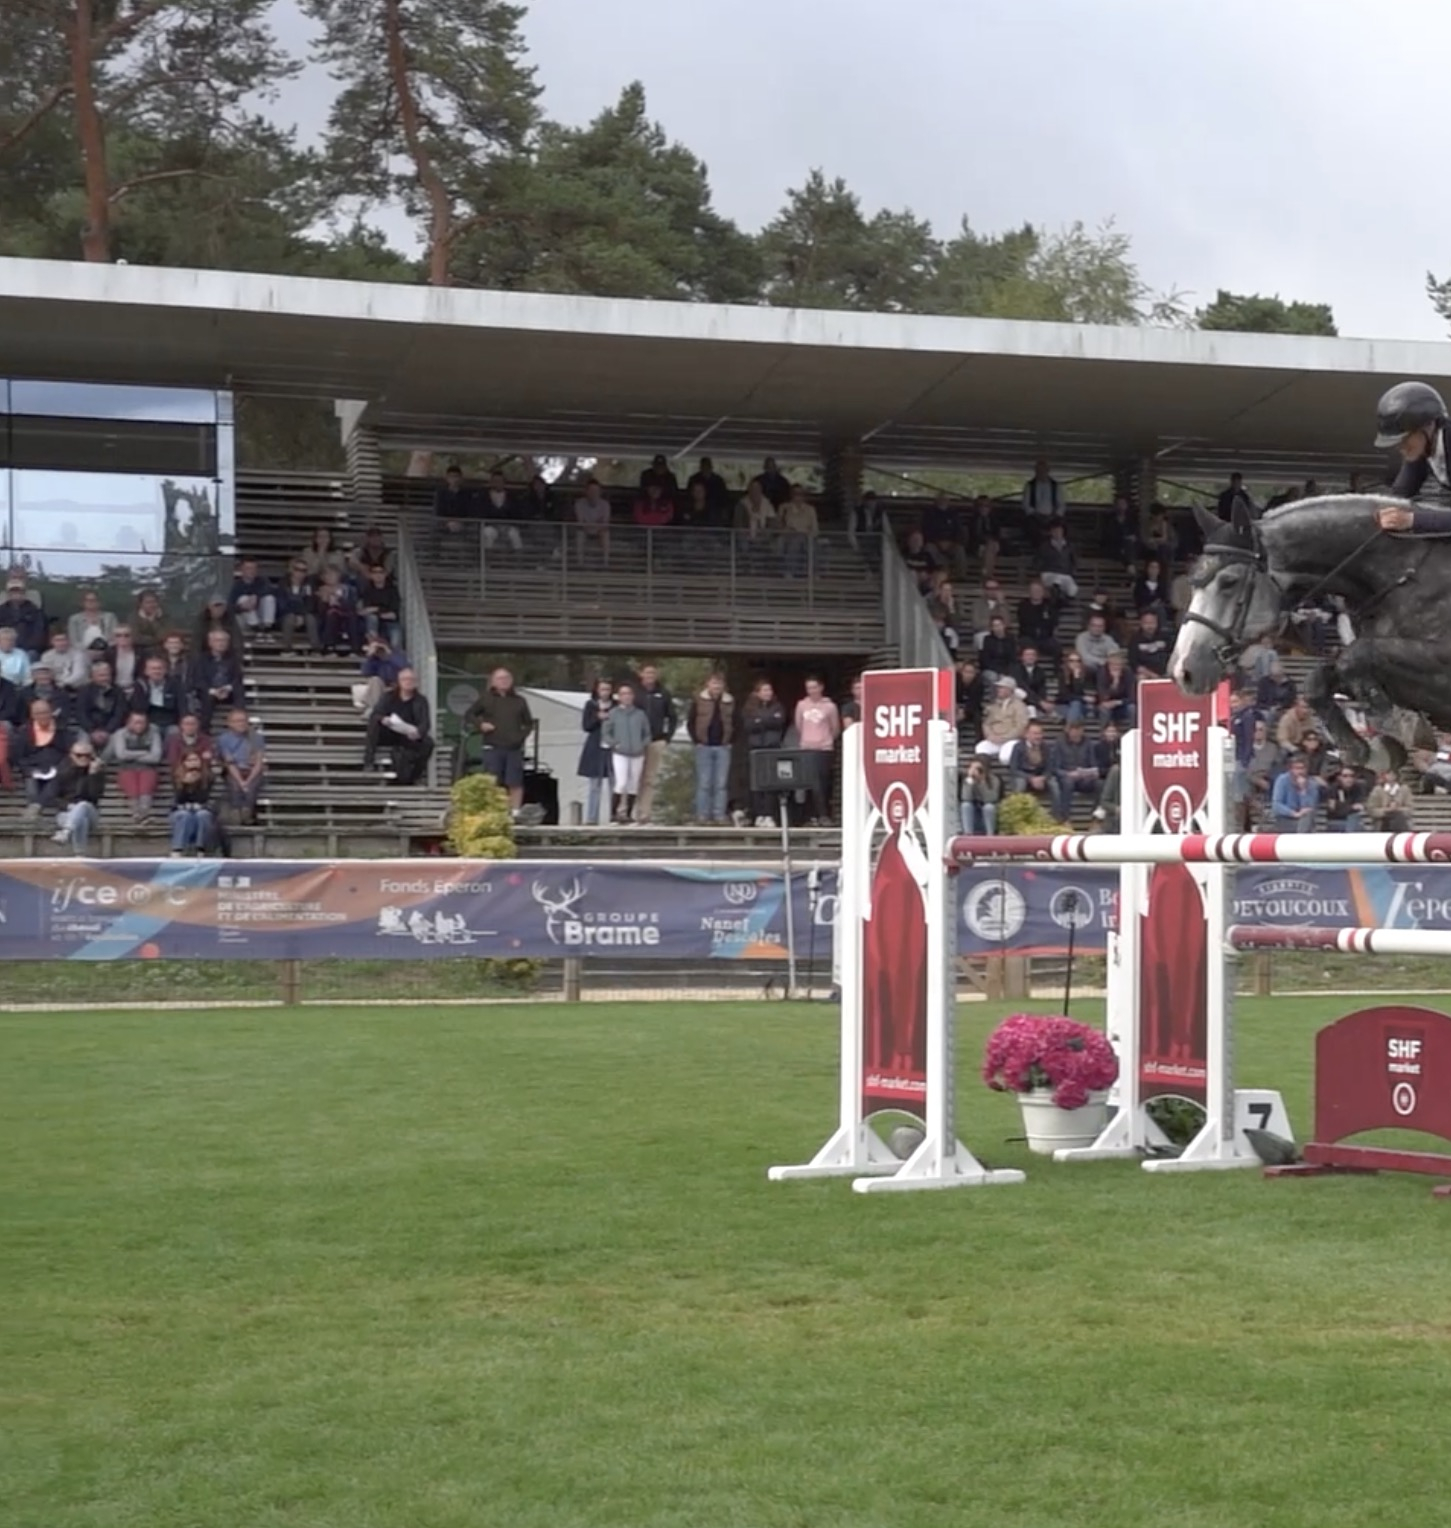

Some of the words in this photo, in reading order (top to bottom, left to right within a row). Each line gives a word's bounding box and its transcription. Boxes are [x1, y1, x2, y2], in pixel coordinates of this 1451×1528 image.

[875, 704, 922, 738] SHF
[1152, 712, 1200, 743] SHF
[875, 745, 921, 763] market
[1152, 750, 1199, 768] market
[379, 878, 430, 893] Fonds
[433, 879, 493, 896] Eperon
[583, 912, 660, 923] GROUPE
[563, 920, 660, 945] Brame
[1388, 1038, 1421, 1058] SHF
[1248, 1103, 1272, 1130] 7
